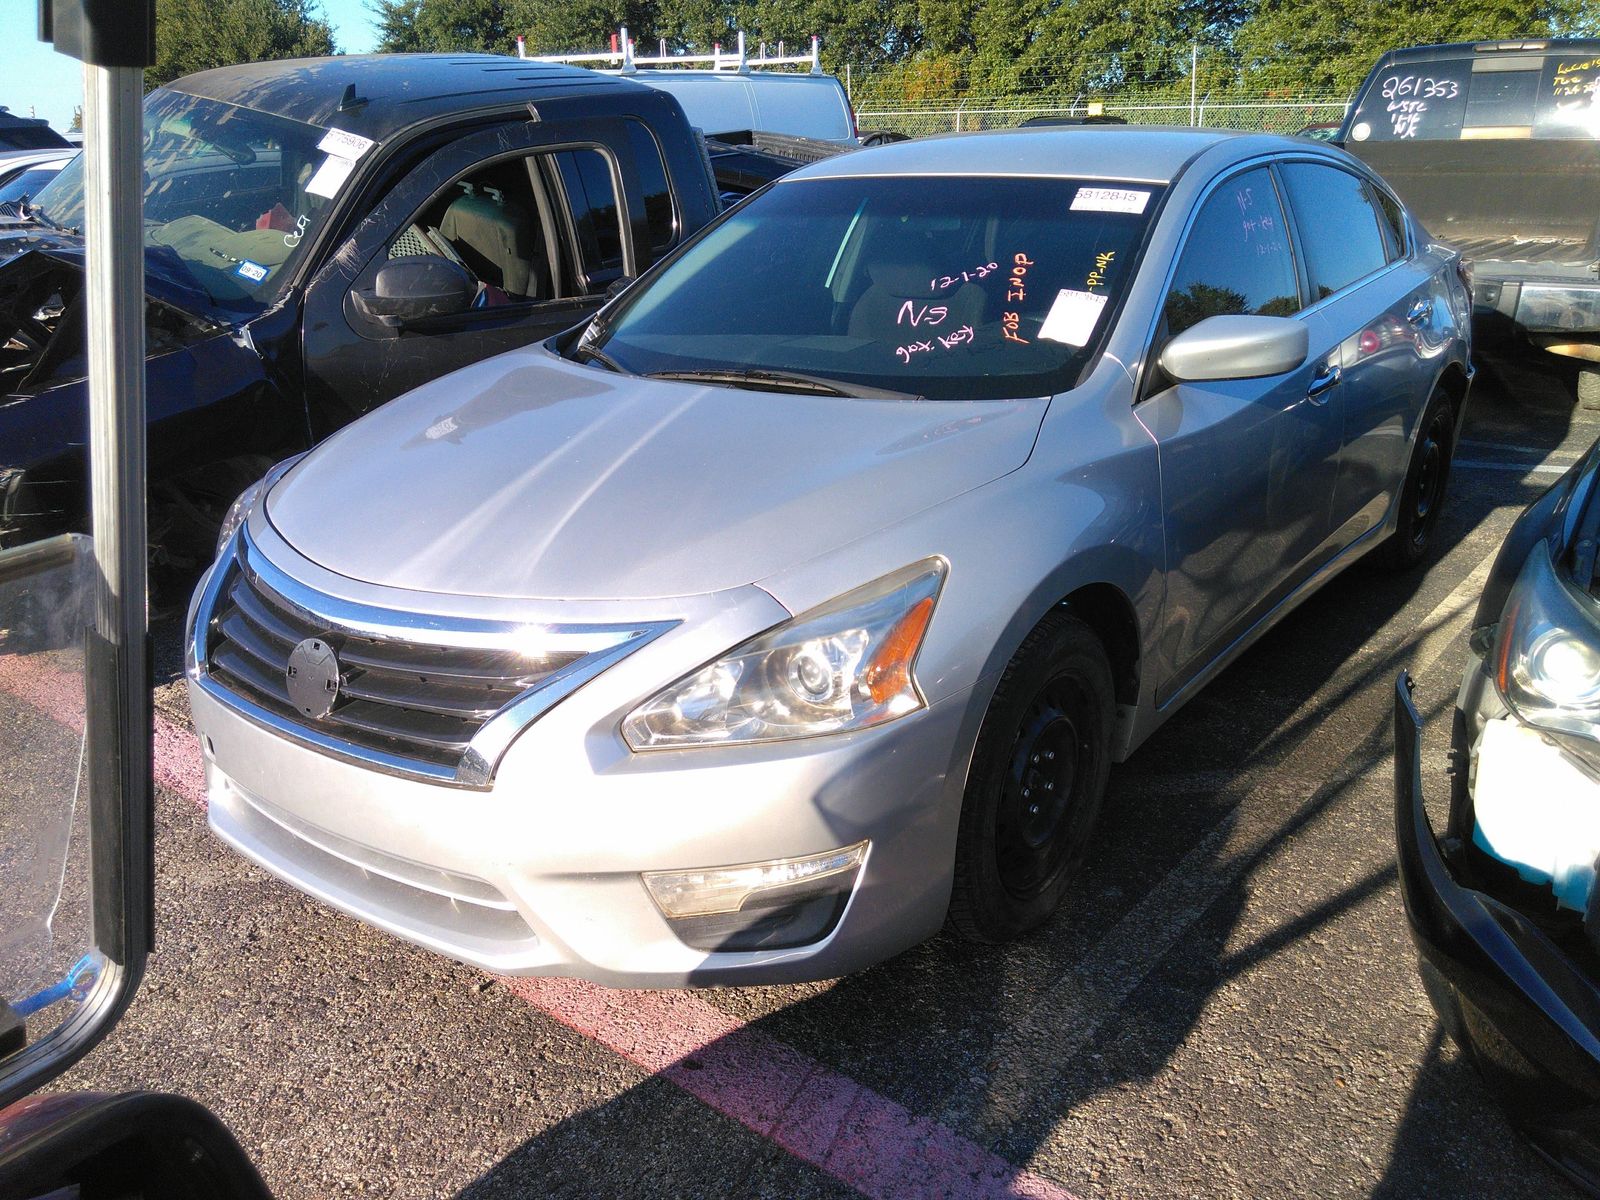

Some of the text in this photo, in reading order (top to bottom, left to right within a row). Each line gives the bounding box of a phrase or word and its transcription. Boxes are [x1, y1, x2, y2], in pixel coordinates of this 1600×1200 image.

[1381, 75, 1459, 100] 261353
[929, 261, 999, 291] 12-1-20
[1002, 252, 1035, 345] FOB INOP
